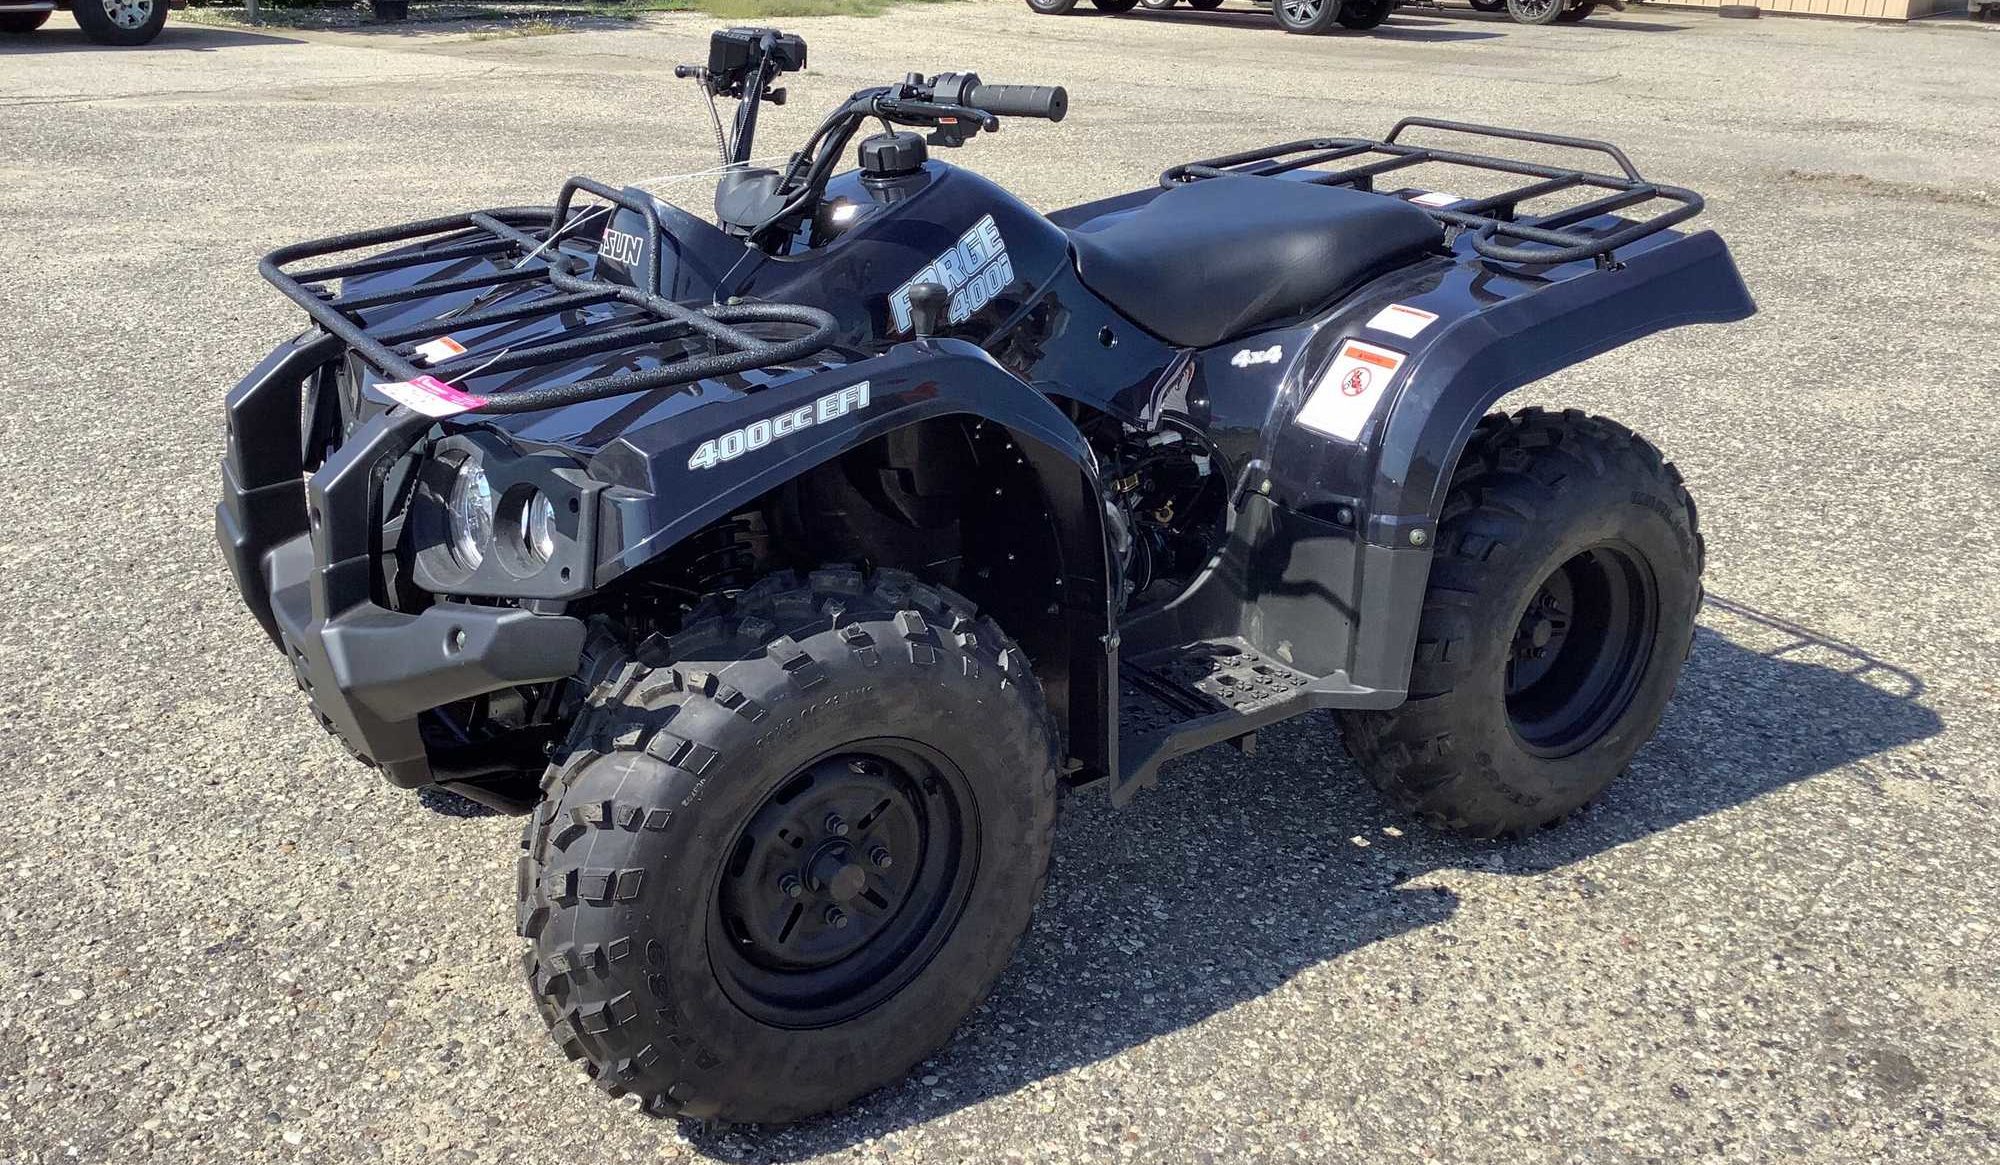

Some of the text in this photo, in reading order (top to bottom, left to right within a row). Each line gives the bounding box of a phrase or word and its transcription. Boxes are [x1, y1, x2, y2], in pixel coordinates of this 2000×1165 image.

[598, 228, 643, 266] SUN
[948, 252, 1014, 325] 400i
[817, 380, 870, 424] EFI
